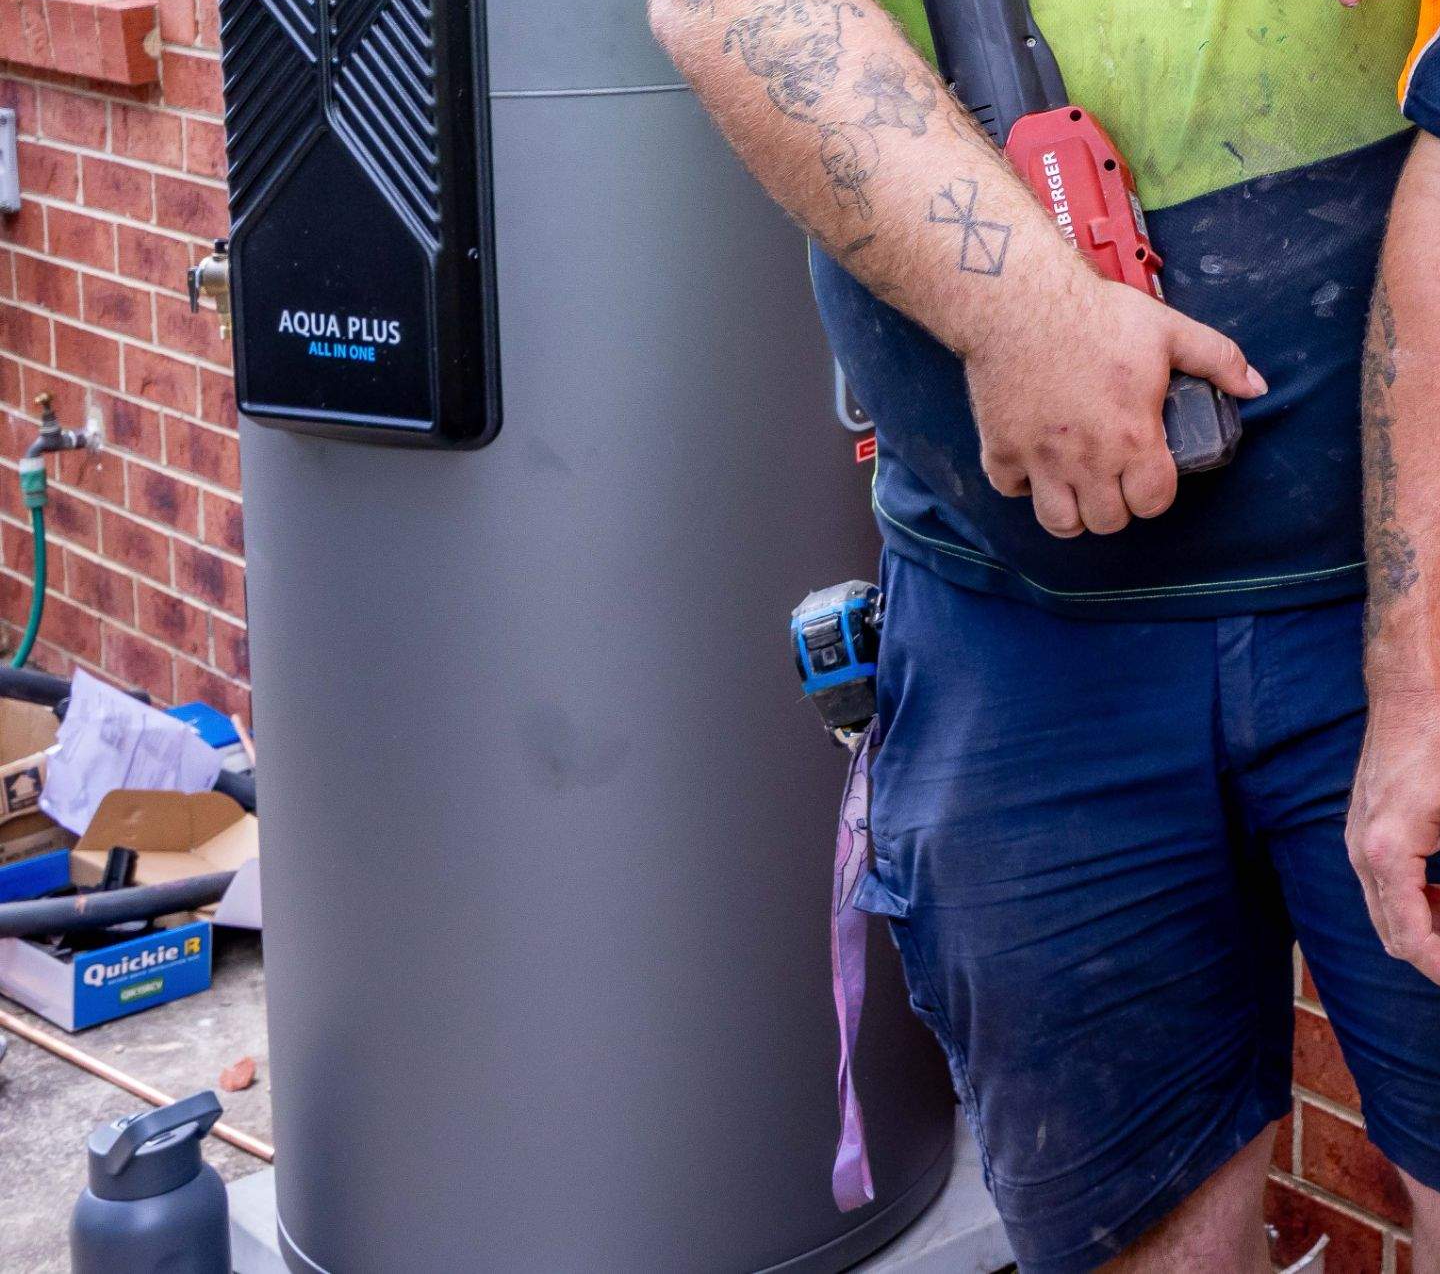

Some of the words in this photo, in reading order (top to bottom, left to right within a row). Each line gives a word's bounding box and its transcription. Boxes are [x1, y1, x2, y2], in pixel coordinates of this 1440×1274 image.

[279, 309, 341, 338] AQUA
[347, 316, 401, 345] PLUS
[309, 341, 332, 357] ALL
[333, 343, 347, 359] IN
[349, 345, 376, 362] ONE
[83, 945, 179, 988] Quickie
